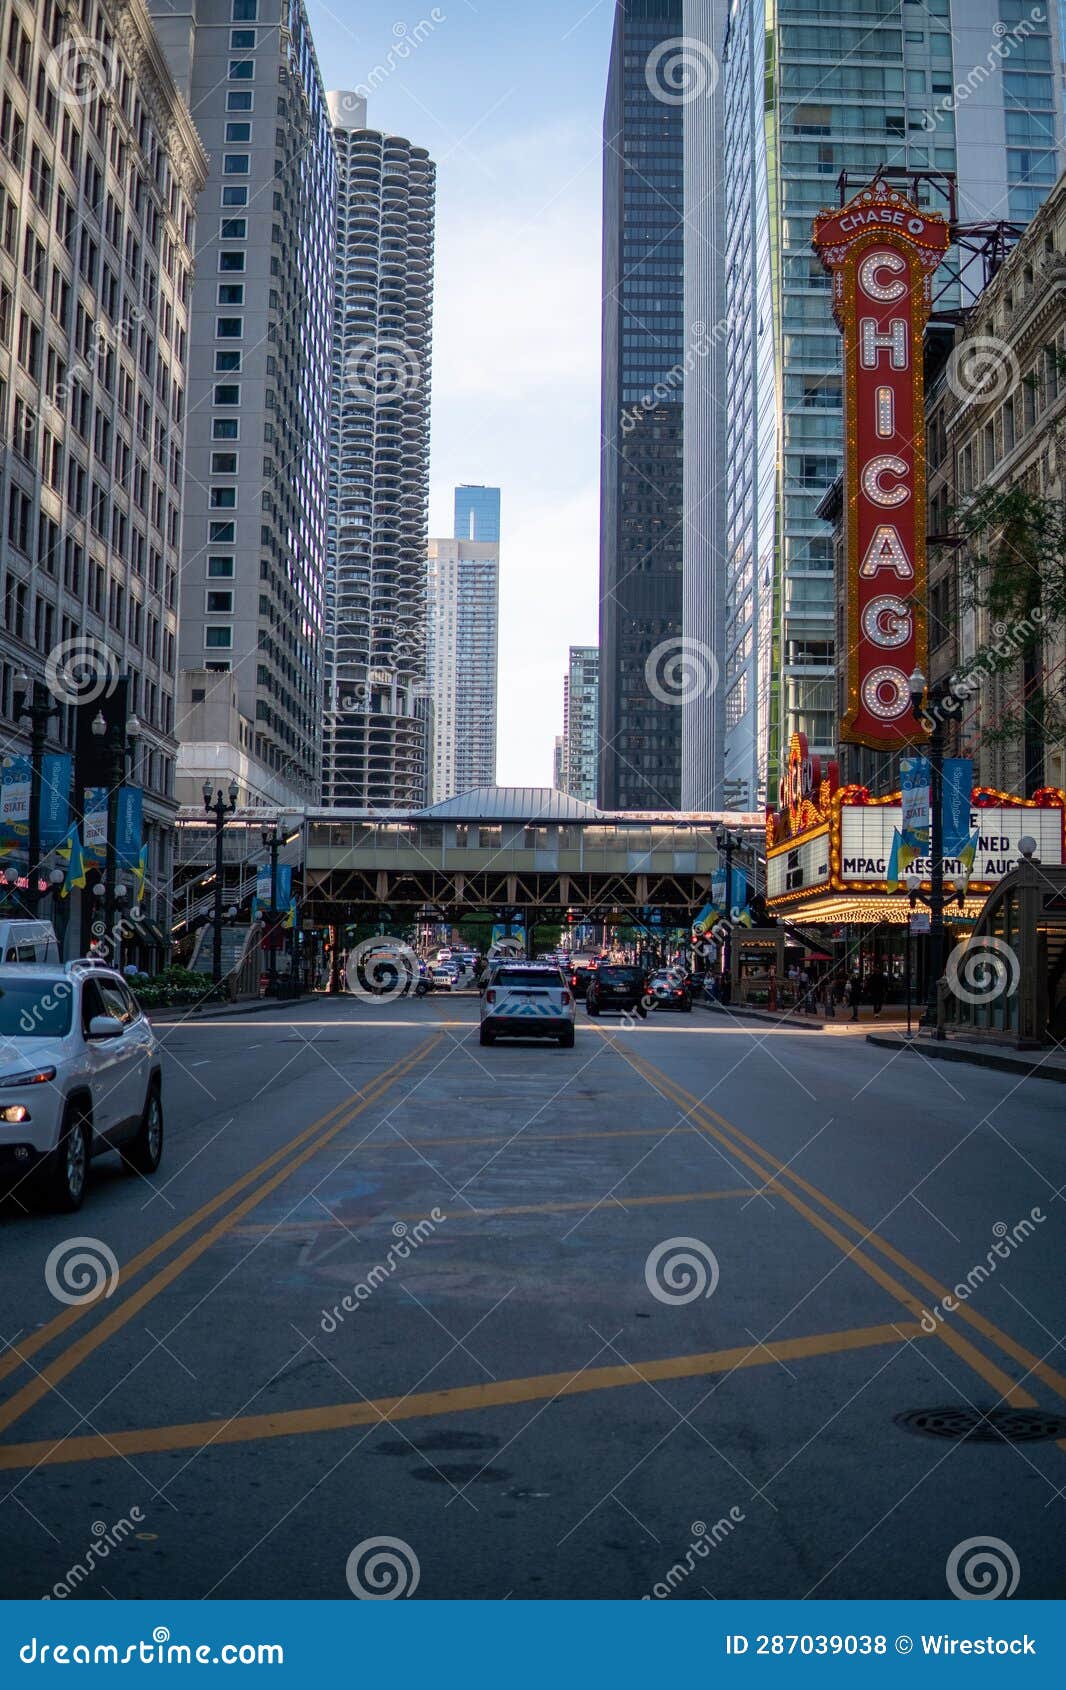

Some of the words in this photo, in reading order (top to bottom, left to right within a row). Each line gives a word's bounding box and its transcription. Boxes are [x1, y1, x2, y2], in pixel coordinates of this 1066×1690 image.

[840, 208, 905, 232] CHASE
[858, 252, 914, 721] CHICAGO
[3, 801, 27, 813] STATE
[906, 807, 927, 819] STATE
